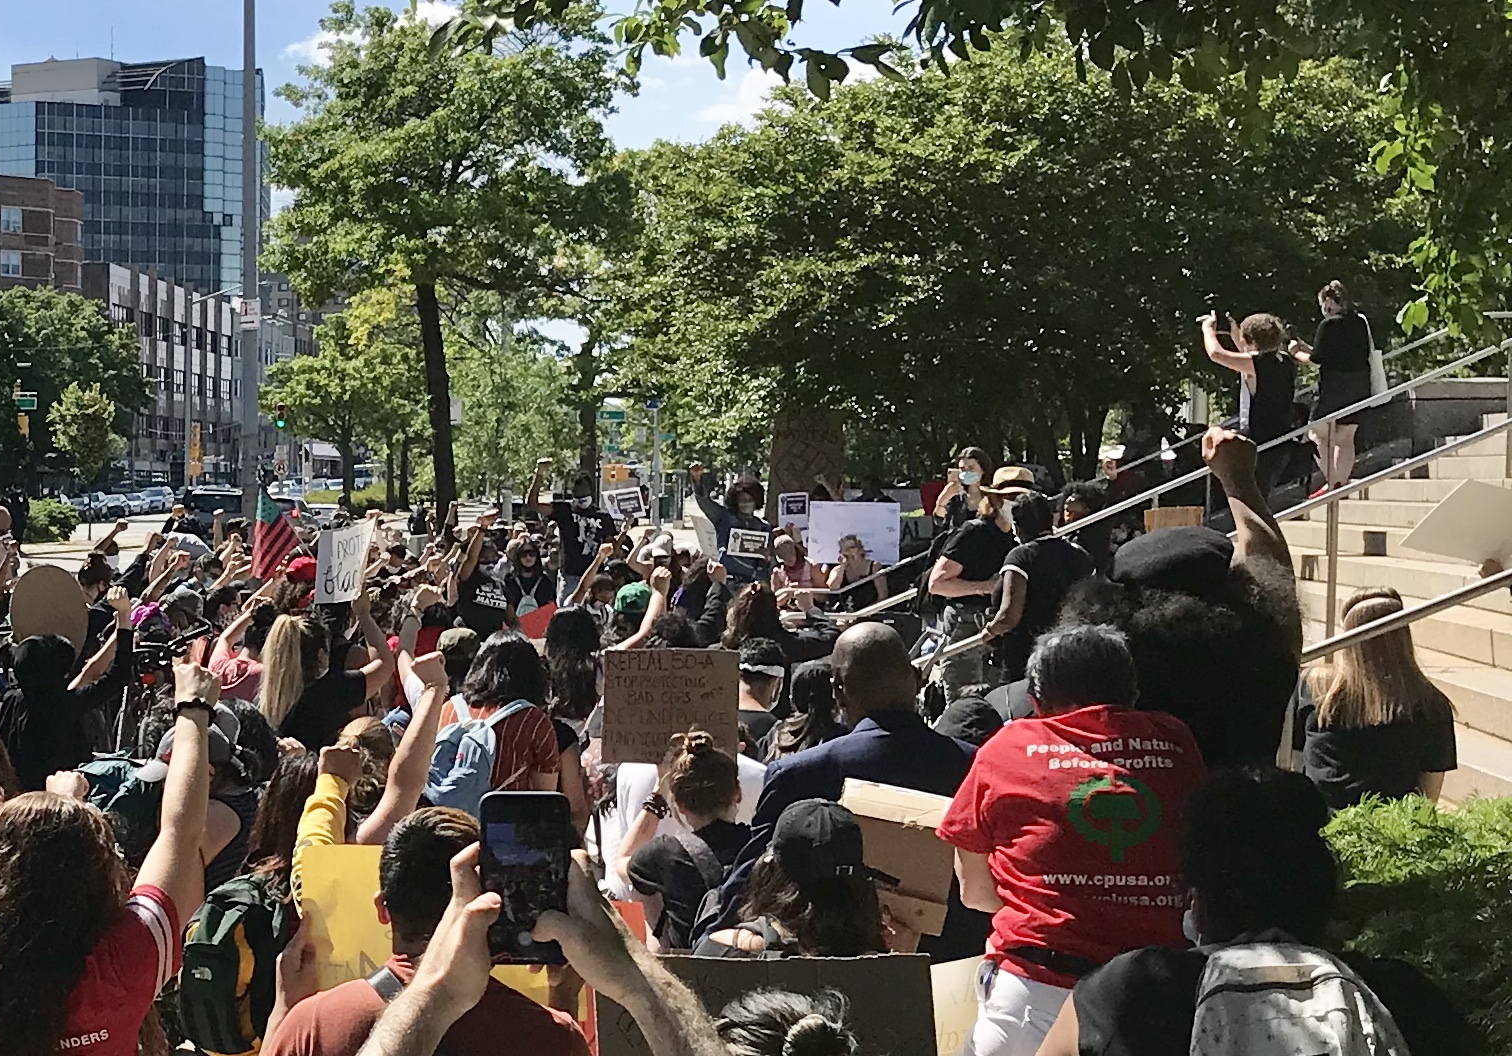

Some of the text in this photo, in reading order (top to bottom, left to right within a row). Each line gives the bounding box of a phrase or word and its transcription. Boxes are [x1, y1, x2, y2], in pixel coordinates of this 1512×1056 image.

[337, 533, 366, 560] PROTE
[323, 561, 359, 595] blac
[671, 653, 714, 670] 50-A
[1090, 738, 1123, 754] and
[1048, 757, 1108, 770] Before
